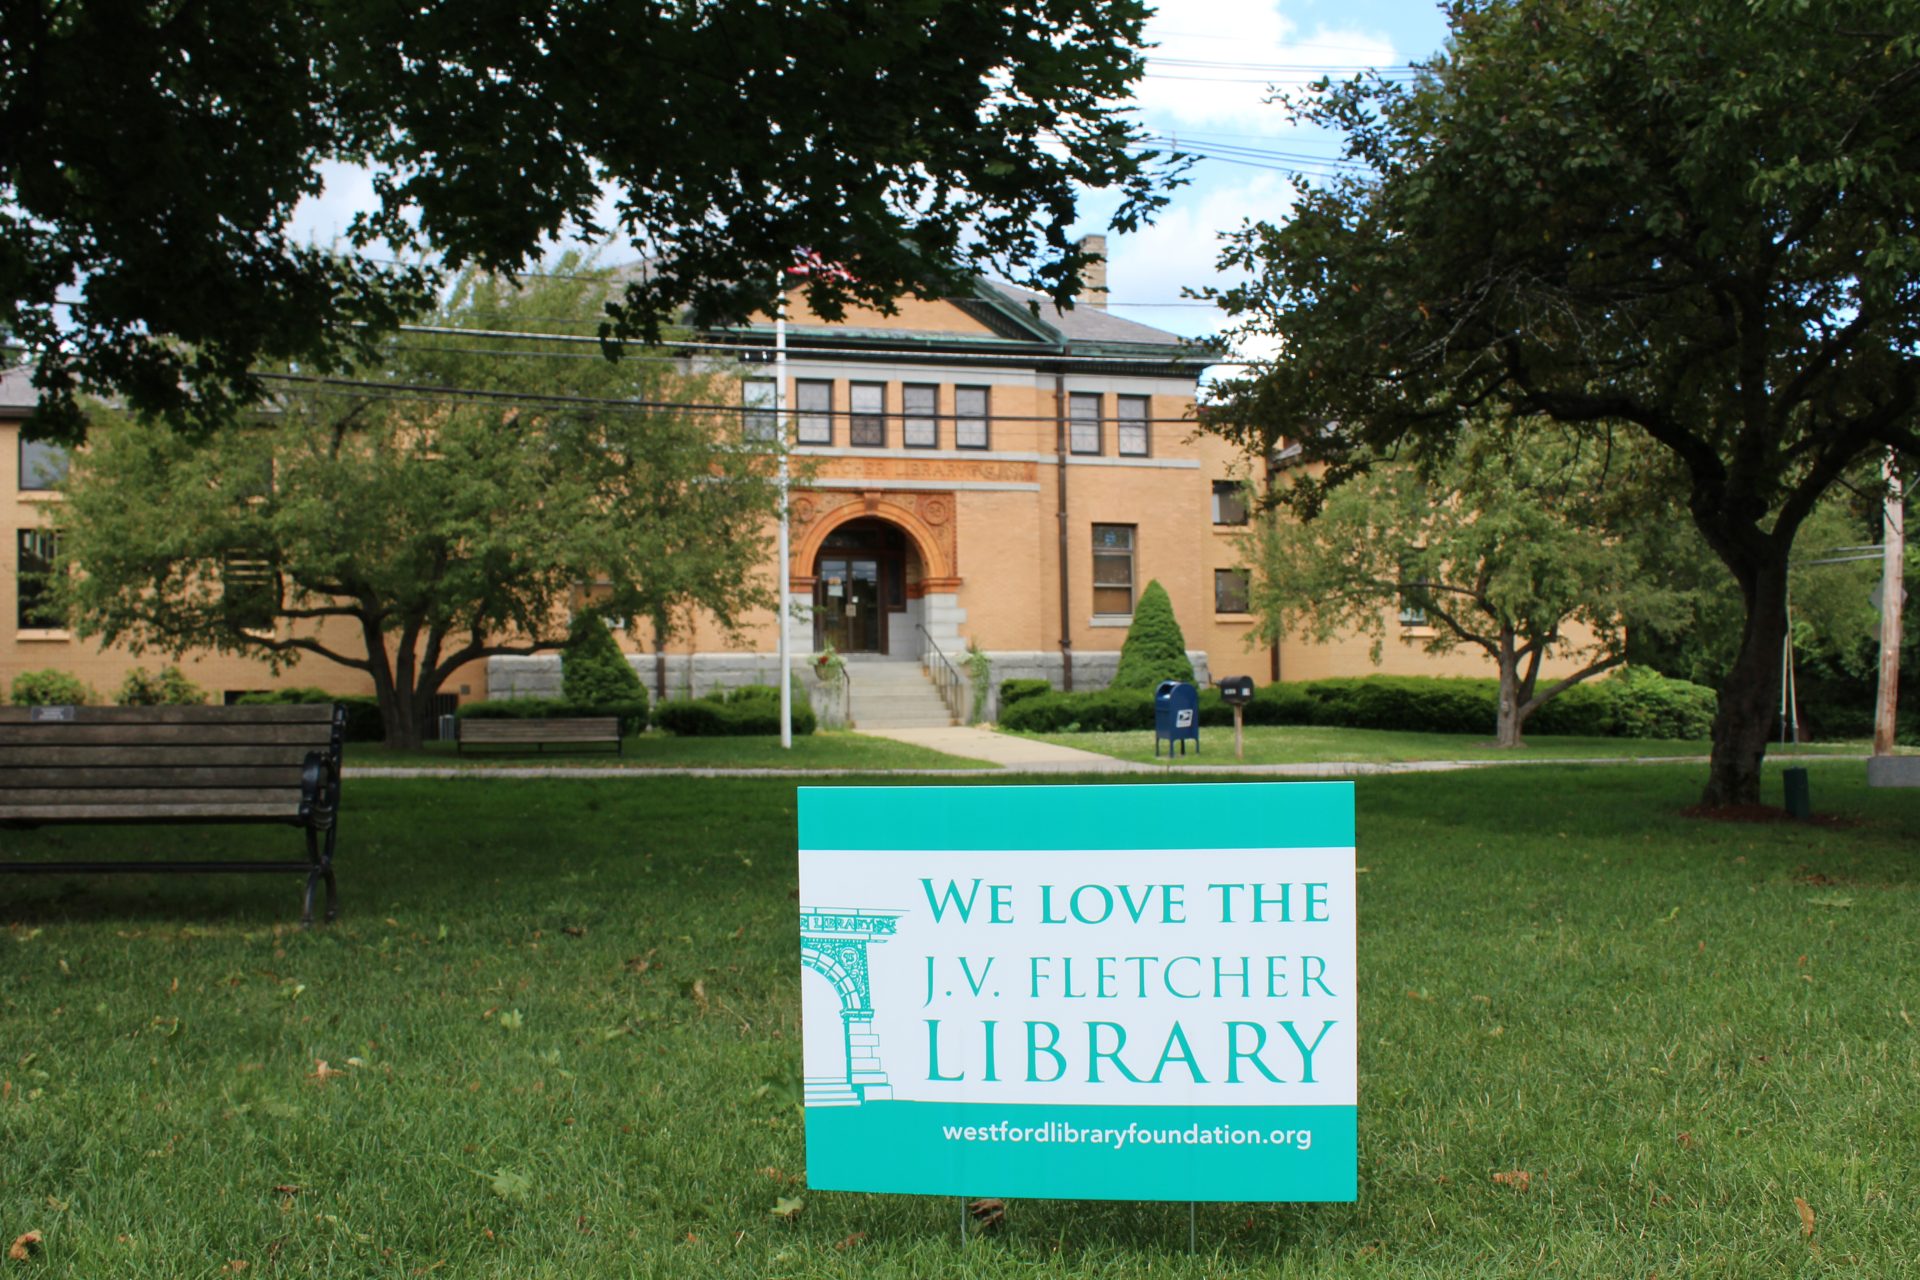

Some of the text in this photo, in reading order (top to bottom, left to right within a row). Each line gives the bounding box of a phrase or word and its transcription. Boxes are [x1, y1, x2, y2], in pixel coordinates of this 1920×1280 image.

[1040, 884, 1186, 925] LOVE
[1208, 882, 1330, 924] THE
[923, 955, 1337, 1007] J.V. FLETCHER
[924, 1019, 1338, 1084] LIBRARY
[943, 1120, 1312, 1151] westfordlibraryfoundation.org
